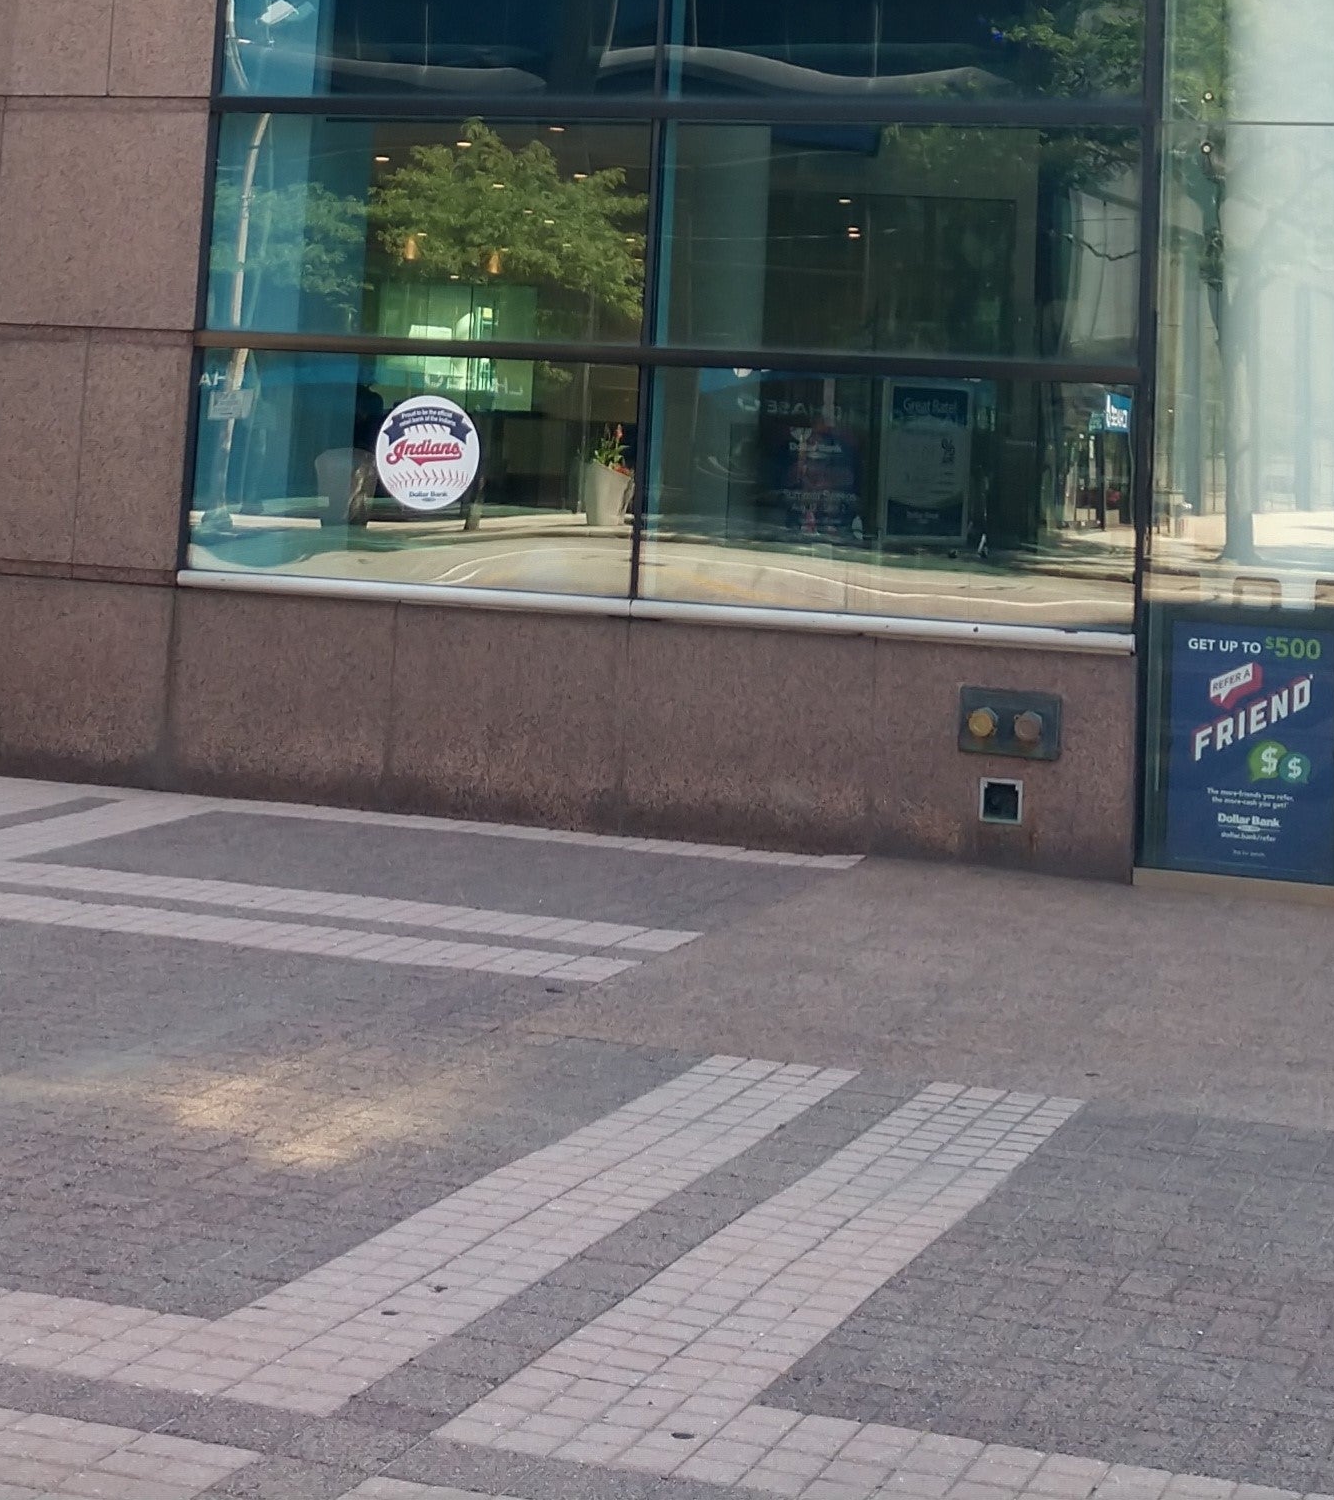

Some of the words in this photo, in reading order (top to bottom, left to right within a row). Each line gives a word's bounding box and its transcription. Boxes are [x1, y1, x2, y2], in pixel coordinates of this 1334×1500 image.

[386, 439, 463, 466] Indians
[1188, 638, 1215, 651] GET
[1219, 639, 1239, 652] UP
[1241, 640, 1262, 654] TO
[1265, 636, 1322, 660] $500
[1212, 672, 1242, 692] REFER
[1243, 669, 1251, 679] A
[1194, 677, 1312, 762] FRIEND
[1218, 812, 1250, 825] Dollar
[1251, 815, 1280, 828] Bank
